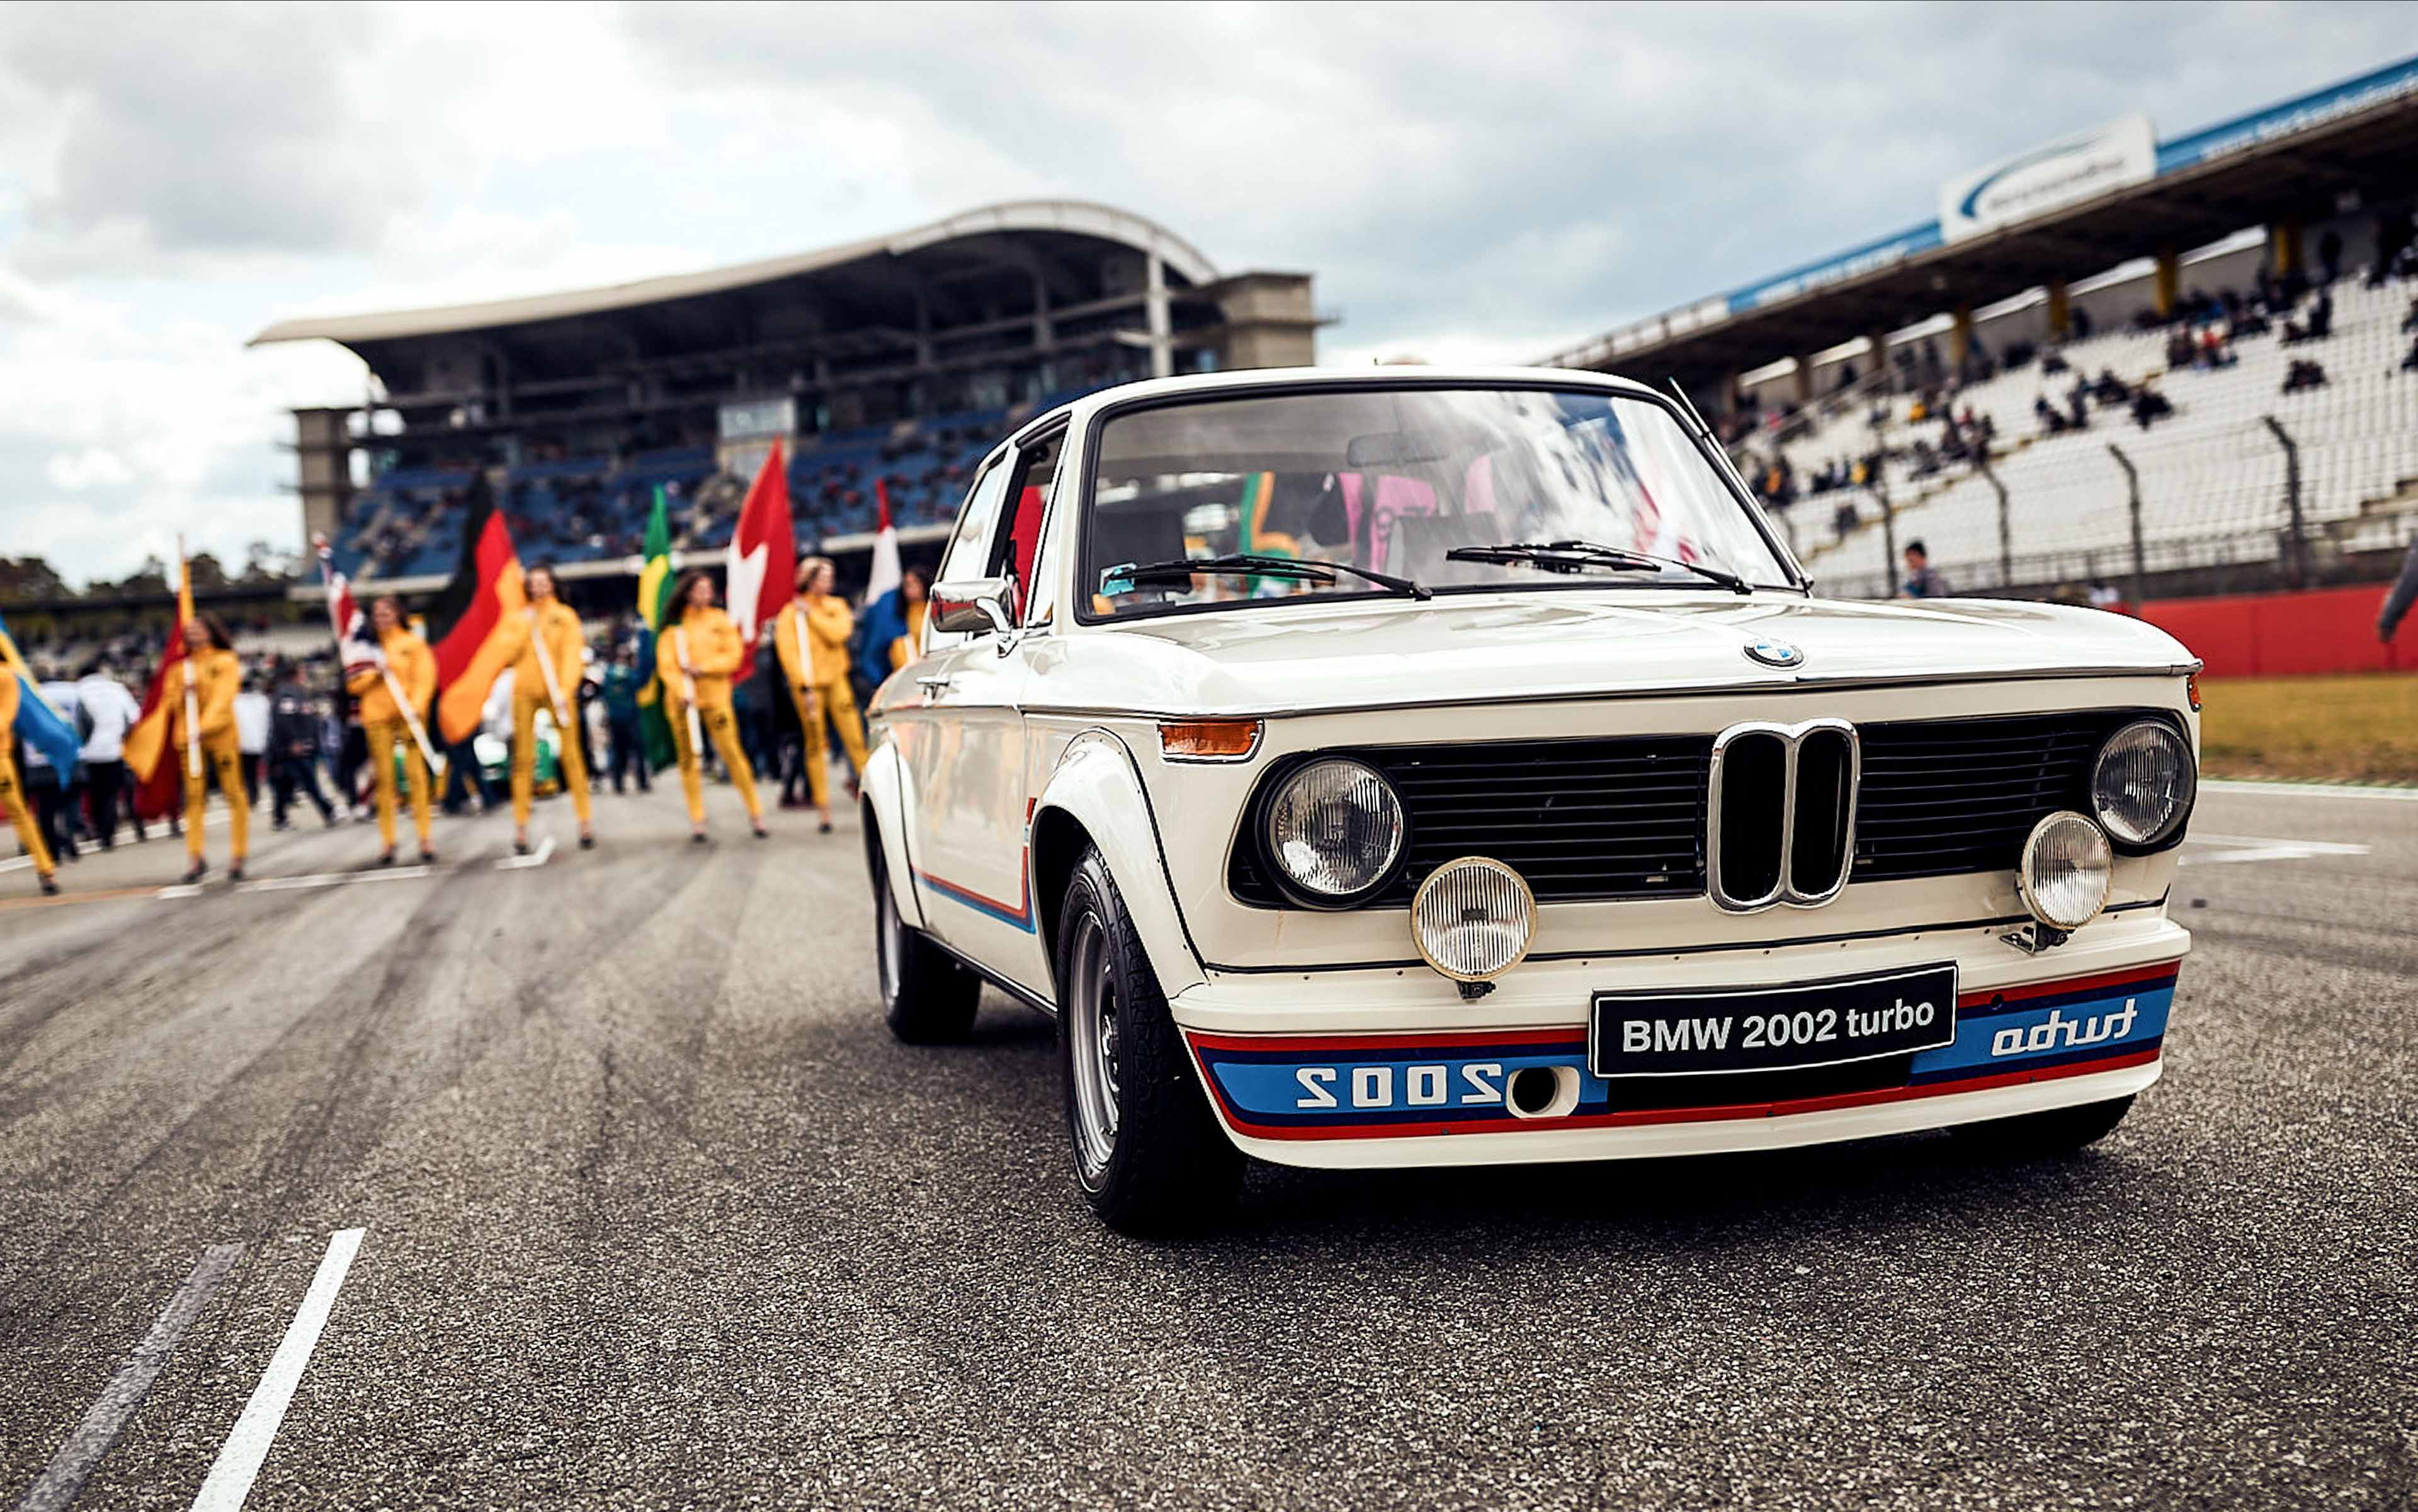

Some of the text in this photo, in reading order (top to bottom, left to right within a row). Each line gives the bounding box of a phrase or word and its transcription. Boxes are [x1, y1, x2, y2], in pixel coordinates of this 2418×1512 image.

[1623, 998, 1934, 1052] BMW 2002 turbo
